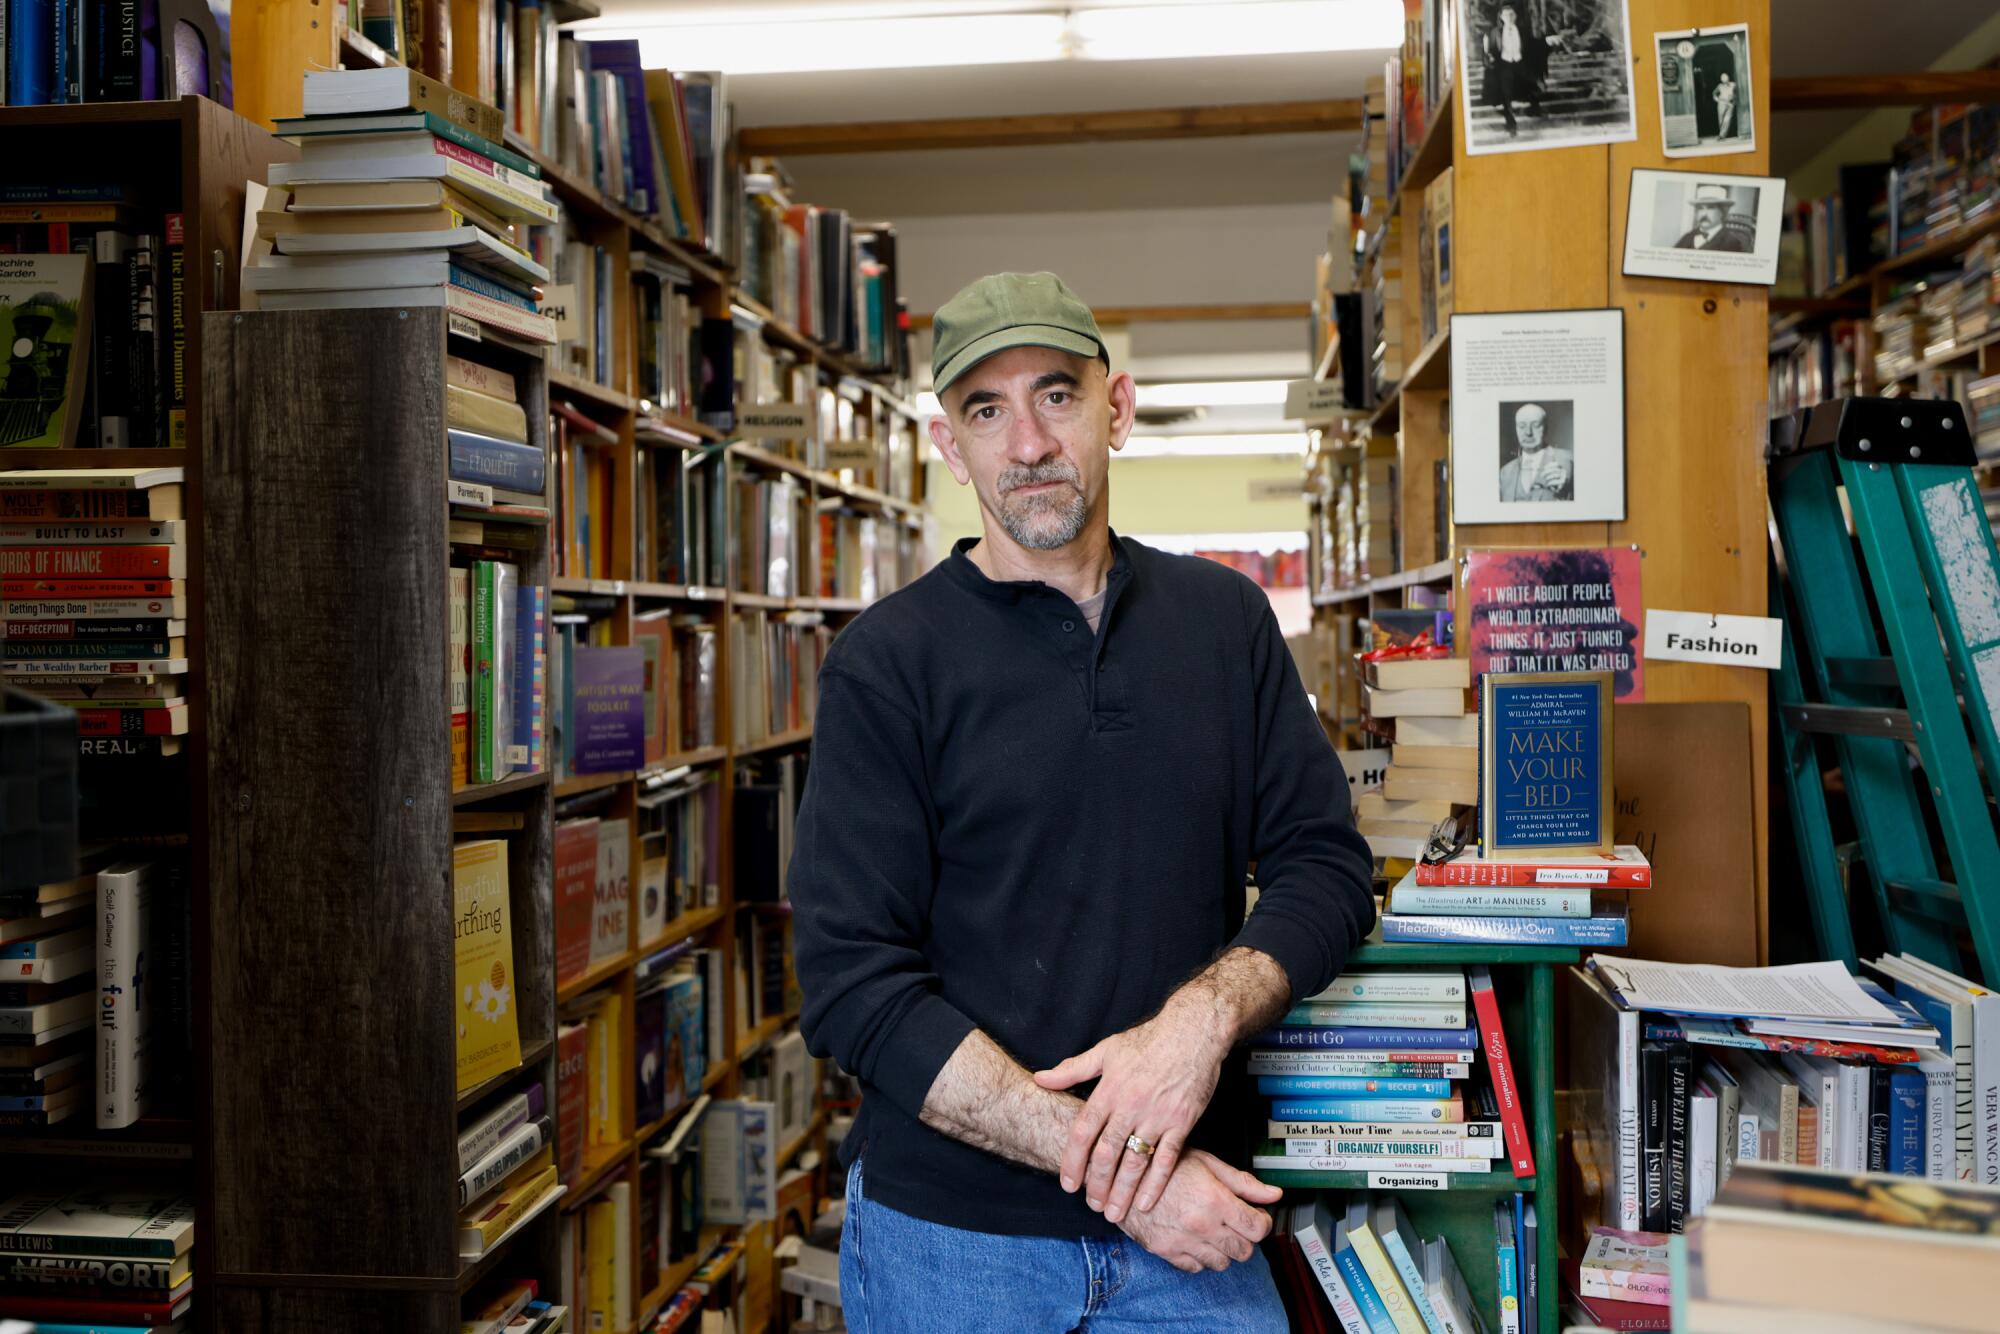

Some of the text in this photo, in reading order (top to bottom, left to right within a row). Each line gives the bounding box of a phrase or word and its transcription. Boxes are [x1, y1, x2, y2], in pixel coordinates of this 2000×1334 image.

[120, 1, 135, 57] JUSTICE
[171, 251, 185, 400] The Internet Dummies
[451, 317, 479, 338] Weddings
[744, 416, 803, 426] RELIGION
[469, 453, 518, 479] ETIQUETTE
[4, 494, 45, 507] WOLF
[457, 485, 484, 503] Parenting
[36, 528, 125, 539] BUILT TO LAST
[35, 551, 49, 574] OF
[55, 550, 103, 574] FINANCE
[1496, 582, 1611, 603] WRITE ABOUT PEOPLE
[9, 602, 38, 616] Getting
[39, 602, 65, 616] Things
[67, 602, 87, 614] Done
[476, 587, 488, 643] Parenting
[1488, 606, 1621, 627] WHO DO EXTRAORDINARY
[9, 623, 69, 635] SELF-DECEPTION
[70, 643, 107, 655] TEAMS
[1489, 630, 1622, 650] THINGS. IT JUST TURNED
[1666, 633, 1758, 656] Fashion
[24, 662, 108, 673] The Wealthy Barber
[1490, 653, 1629, 672] OUT THAT IT WAS CALLED
[587, 700, 629, 713] TOOLKIT
[1508, 710, 1541, 718] WILLIAM
[1553, 709, 1586, 717] McRAVEN
[81, 740, 137, 755] REAL
[1508, 730, 1586, 754] MAKE
[1507, 757, 1587, 784] YOUR
[1525, 784, 1571, 807] BED
[1585, 872, 1606, 880] M.D.
[1493, 897, 1546, 905] MANLINESS
[1397, 919, 1447, 936] Heading
[1526, 923, 1554, 935] Own
[105, 958, 116, 979] the
[102, 984, 122, 1031] four
[1279, 1031, 1442, 1045] Let it Go PETER WALSH
[1271, 1063, 1300, 1072] Sacred
[1302, 1063, 1330, 1073] Clutter
[1332, 1064, 1367, 1075] Clearing
[1277, 1081, 1294, 1089] THE
[1295, 1081, 1321, 1089] MORE
[1388, 1082, 1417, 1091] BECKER
[1498, 1062, 1513, 1109] minimalism
[1955, 1044, 1973, 1161] ULTIMATE
[1284, 1125, 1309, 1135] Take
[1311, 1125, 1335, 1135] Back
[1339, 1125, 1365, 1135] Your
[1367, 1125, 1393, 1135] Time
[1622, 1106, 1636, 1161] TAHITI
[1903, 1115, 1918, 1150] THE
[1932, 1096, 1943, 1160] SURVEY OF
[1985, 1086, 1998, 1185] VERA WANG ON
[1337, 1142, 1439, 1155] ORGANIZE YOURSELF!
[1671, 1068, 1685, 1212] JEWELRY THROUGH
[1870, 1113, 1888, 1169] California
[473, 1174, 485, 1193] THE
[485, 1147, 519, 1182] DEVELOPING
[1644, 1147, 1665, 1208] FASHION
[1378, 1176, 1439, 1188] Organizing
[18, 1237, 54, 1251] LEWIS
[15, 1257, 170, 1289] NEWPORT
[1315, 1257, 1331, 1280] Rules
[1325, 1281, 1337, 1295] for
[1345, 1257, 1377, 1314] GRETCHEN RUBIN
[1627, 1284, 1649, 1292] CHLOE
[1621, 1319, 1668, 1328] FLORAL
